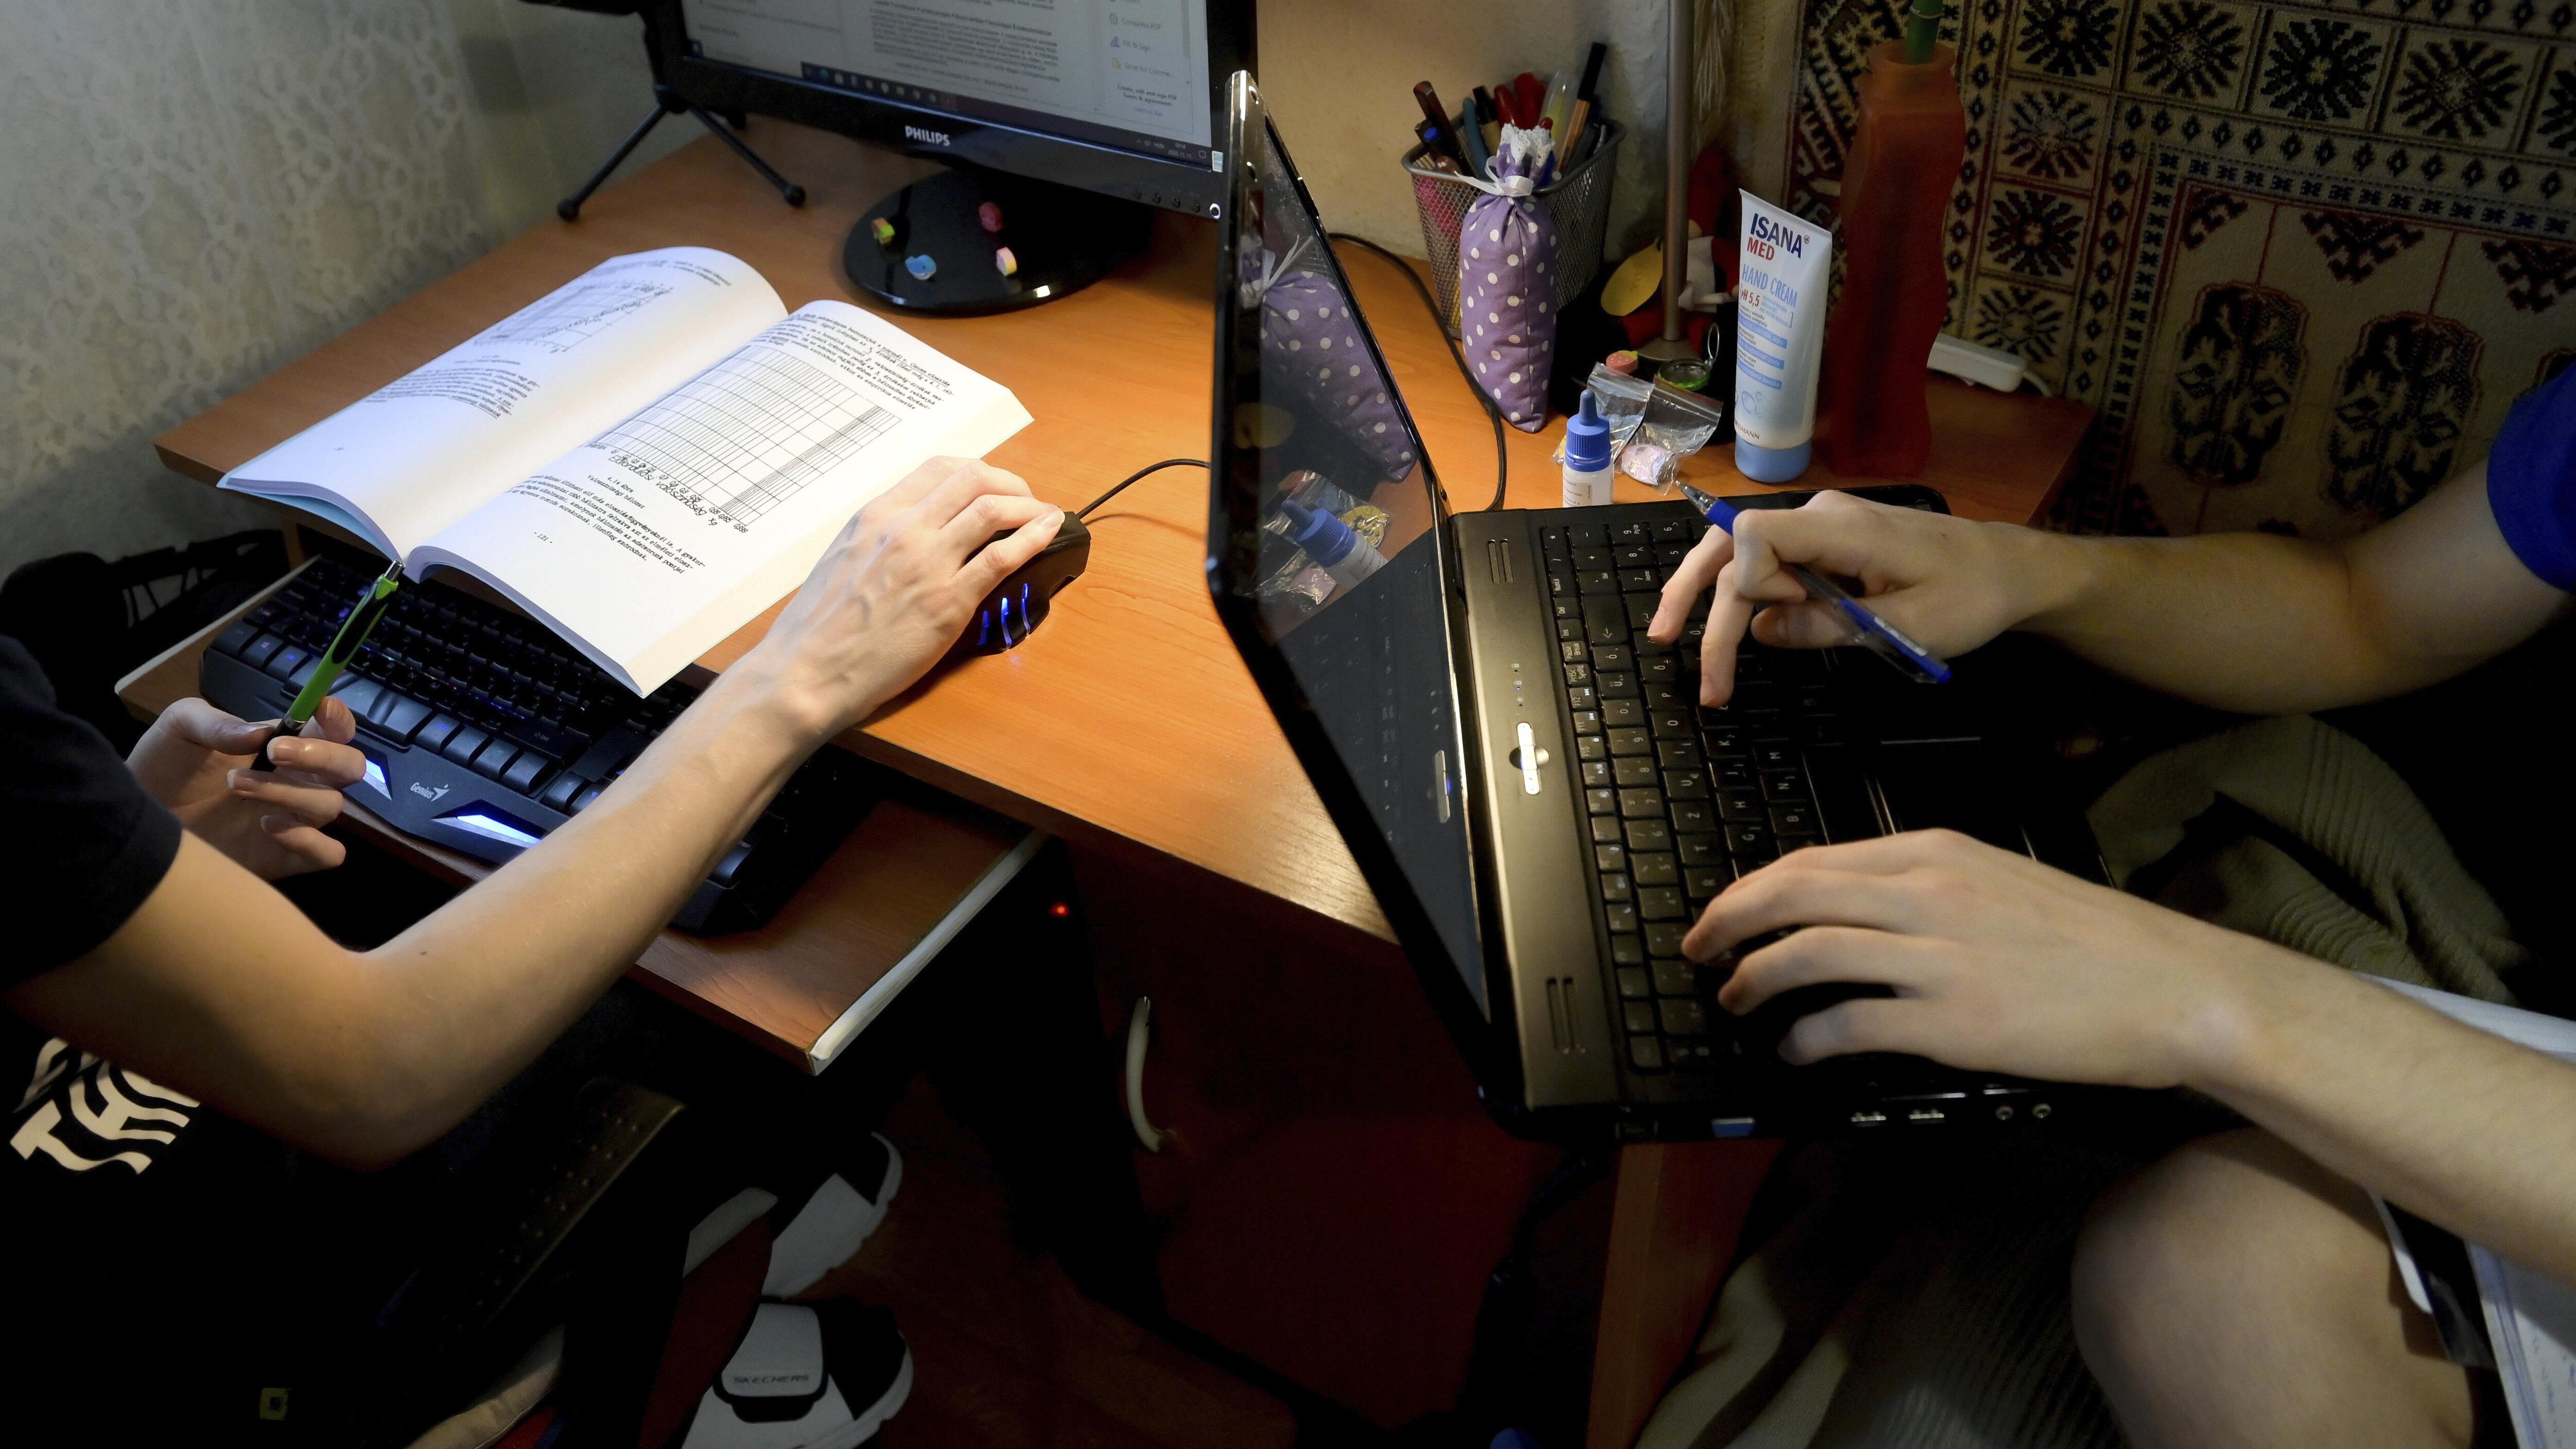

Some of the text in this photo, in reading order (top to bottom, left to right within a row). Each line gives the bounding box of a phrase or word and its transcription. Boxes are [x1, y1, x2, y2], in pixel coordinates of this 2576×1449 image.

[905, 125, 950, 146] PHILIPS
[1750, 213, 1802, 259] ISANA
[1747, 236, 1774, 261] MED
[1742, 264, 1798, 308] HAND CREAM
[1741, 289, 1760, 307] pH 5,5
[1735, 419, 1759, 439] SSMANN
[621, 484, 633, 492] ábra
[623, 495, 645, 508] hálózat
[592, 524, 617, 540] illetőleg
[617, 540, 646, 560] szóródnak.
[607, 514, 631, 529] felrakva
[650, 541, 675, 557] elméleti
[674, 557, 693, 568] elosz-
[632, 539, 663, 560] adatsorunk
[662, 560, 685, 573] pontjai
[681, 553, 705, 567] gyakor-
[410, 782, 434, 798] Genius
[734, 1375, 809, 1384] SKECHERS
